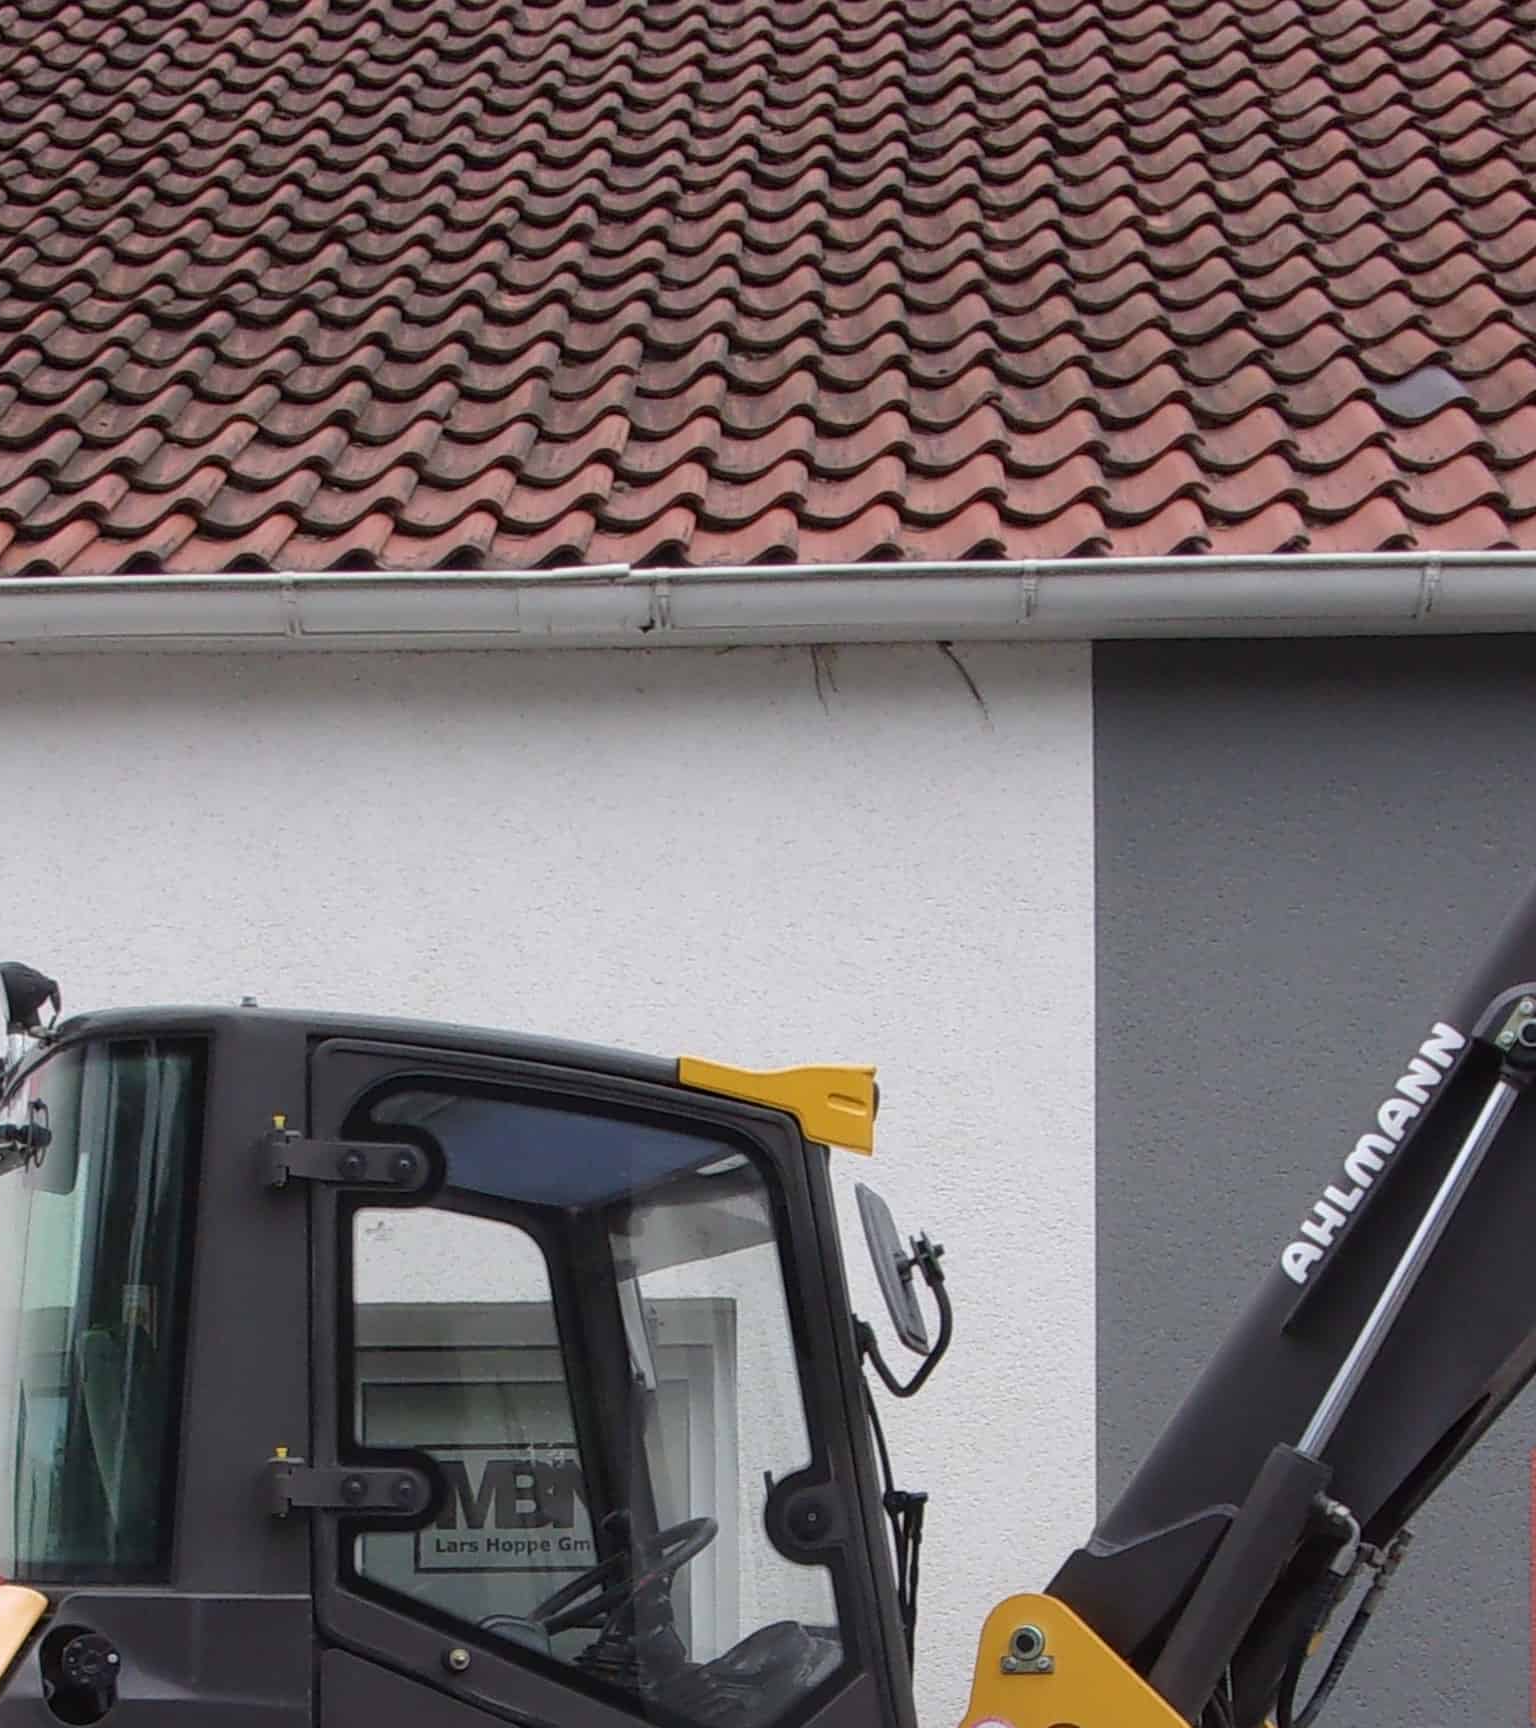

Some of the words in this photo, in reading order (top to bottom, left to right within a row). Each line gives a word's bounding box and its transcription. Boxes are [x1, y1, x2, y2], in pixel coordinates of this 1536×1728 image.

[1281, 1022, 1466, 1285] AHLMANN
[435, 1537, 479, 1553] Lars
[486, 1537, 551, 1557] Hoppe
[558, 1536, 591, 1552] Gm
